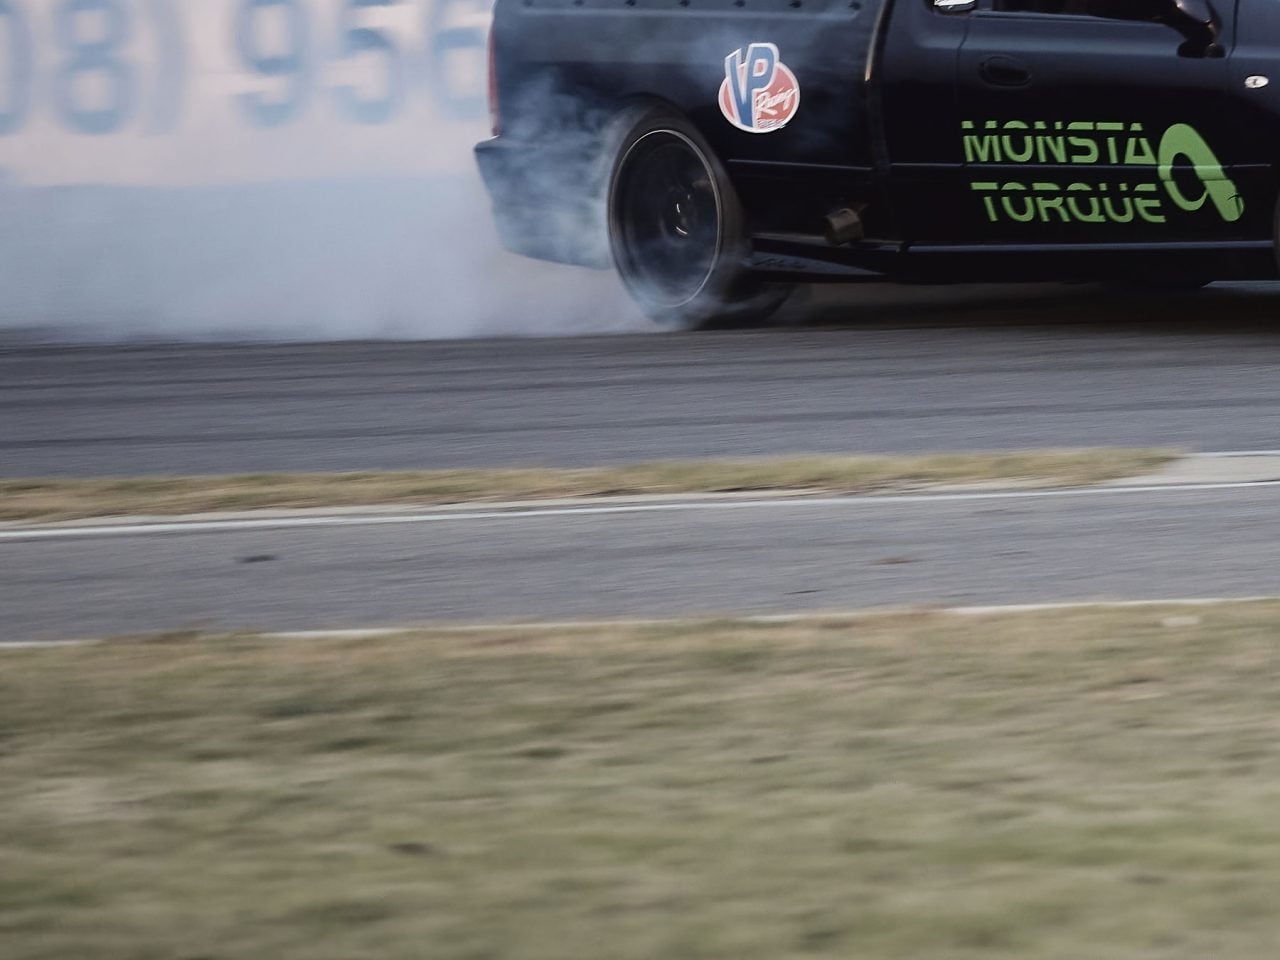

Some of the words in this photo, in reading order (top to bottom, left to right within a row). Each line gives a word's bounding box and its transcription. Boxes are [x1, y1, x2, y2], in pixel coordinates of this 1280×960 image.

[724, 43, 780, 132] VP
[961, 120, 1157, 165] MONSTA
[970, 181, 1167, 223] TORQUE
